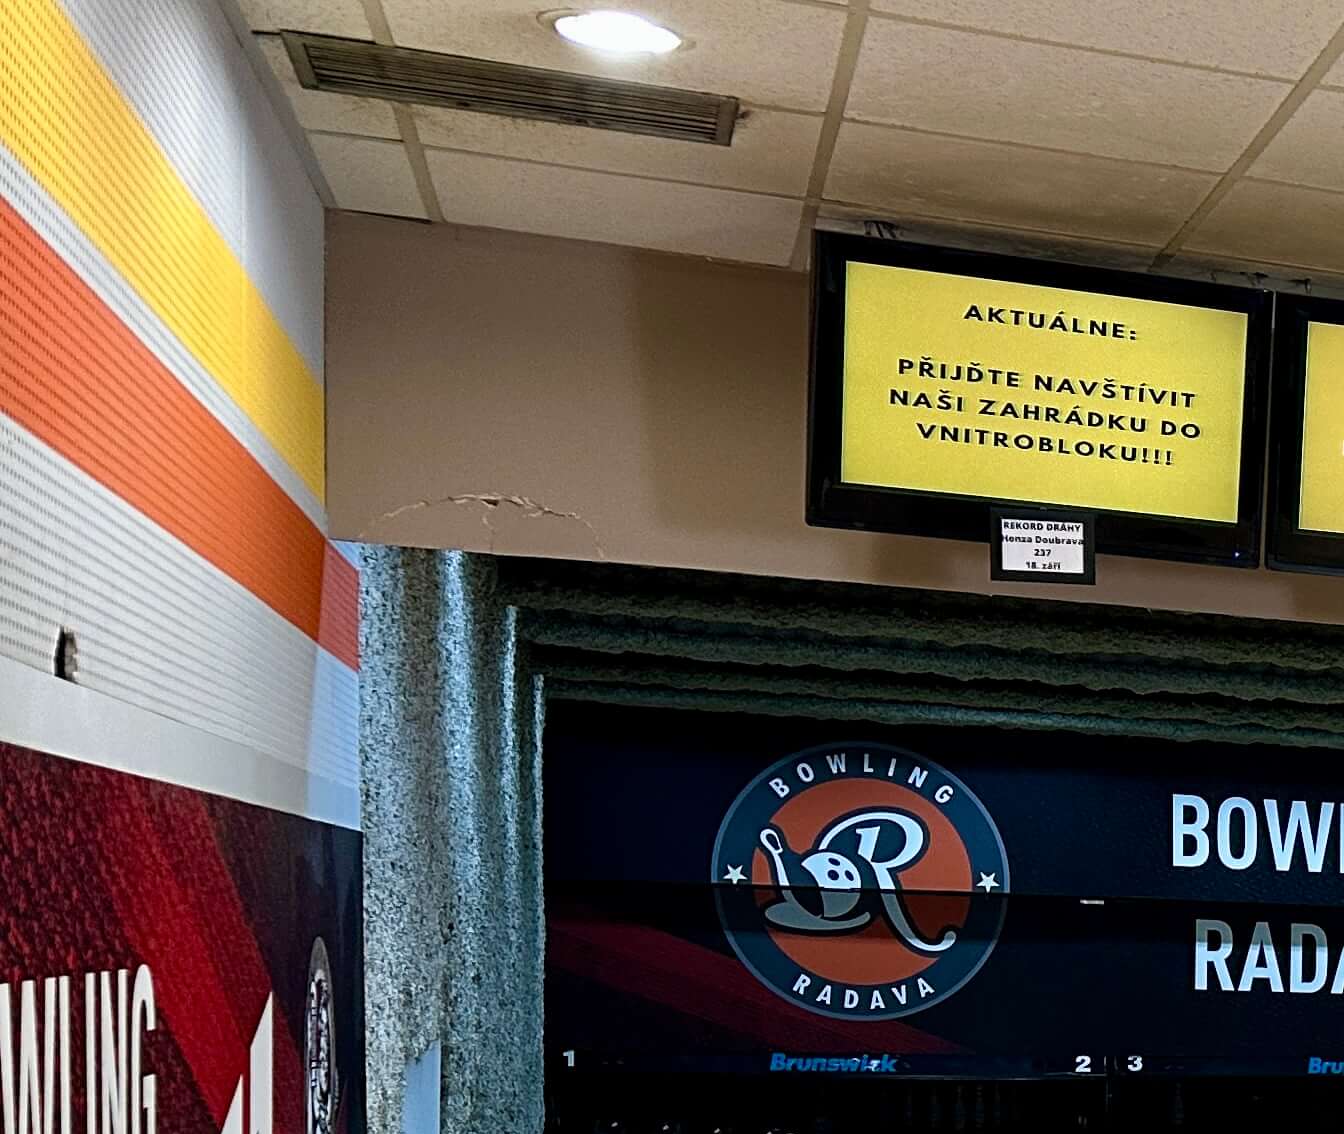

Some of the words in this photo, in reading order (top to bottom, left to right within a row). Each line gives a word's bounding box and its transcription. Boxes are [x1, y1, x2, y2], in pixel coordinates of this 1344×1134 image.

[964, 304, 1138, 341] AKTUÁLNE:
[898, 357, 1020, 388] PŘIJĎTE
[1034, 376, 1196, 408] NAVŠTÍVIT
[890, 388, 964, 413] NAŠI
[978, 399, 1147, 433] ZAHRÁDKU
[1161, 420, 1201, 440] DO
[916, 423, 1173, 466] VNITROBLOKU!!!
[1003, 521, 1043, 531] REKORD
[769, 753, 955, 804] BOWLING
[793, 974, 936, 1010] RADAVA
[563, 1051, 576, 1067] 1
[770, 1052, 897, 1073] Brunswick
[1075, 1056, 1092, 1072] 2
[1127, 1056, 1143, 1072] 3
